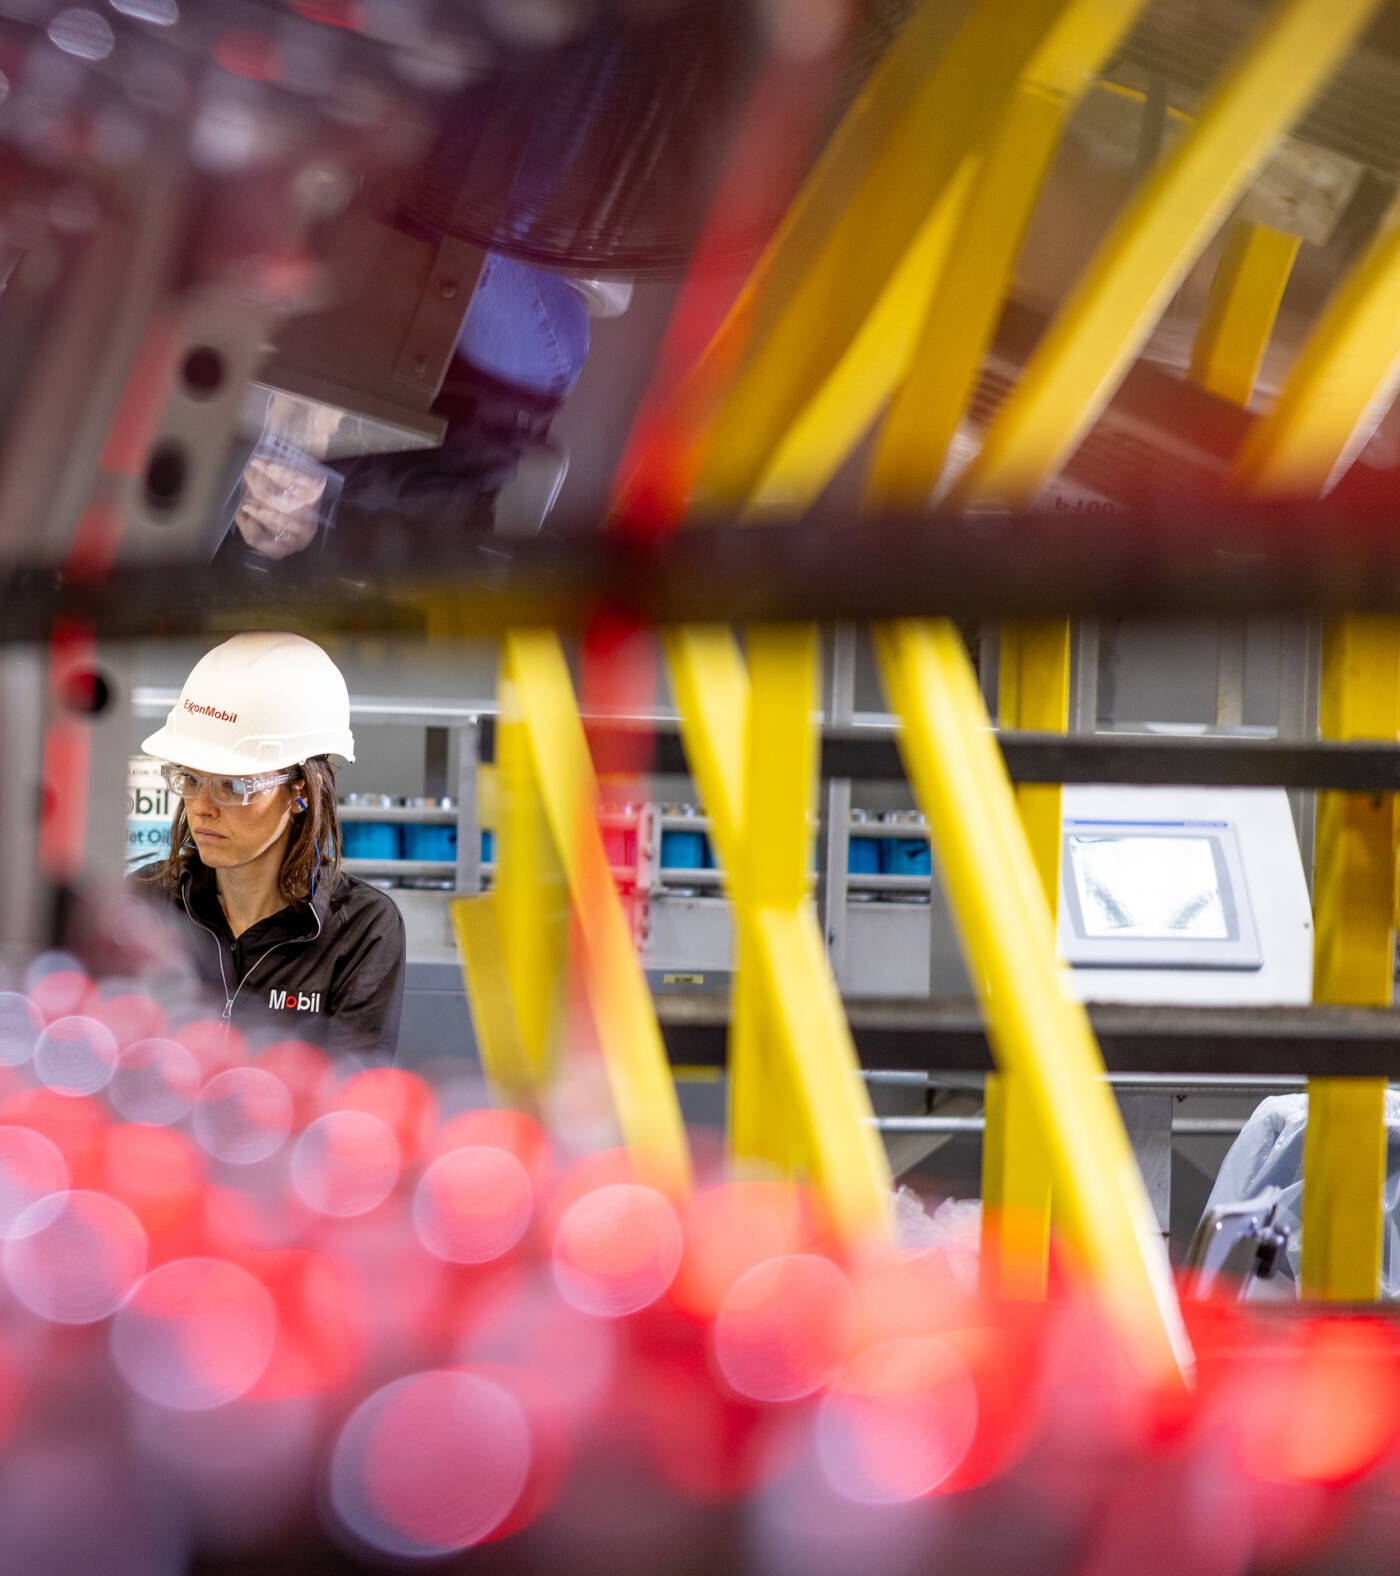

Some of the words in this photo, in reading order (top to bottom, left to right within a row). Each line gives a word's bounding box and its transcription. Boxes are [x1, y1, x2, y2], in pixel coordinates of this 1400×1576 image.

[183, 698, 238, 724] ExxonMobil
[127, 788, 169, 815] bil
[268, 989, 321, 1013] Mobil
